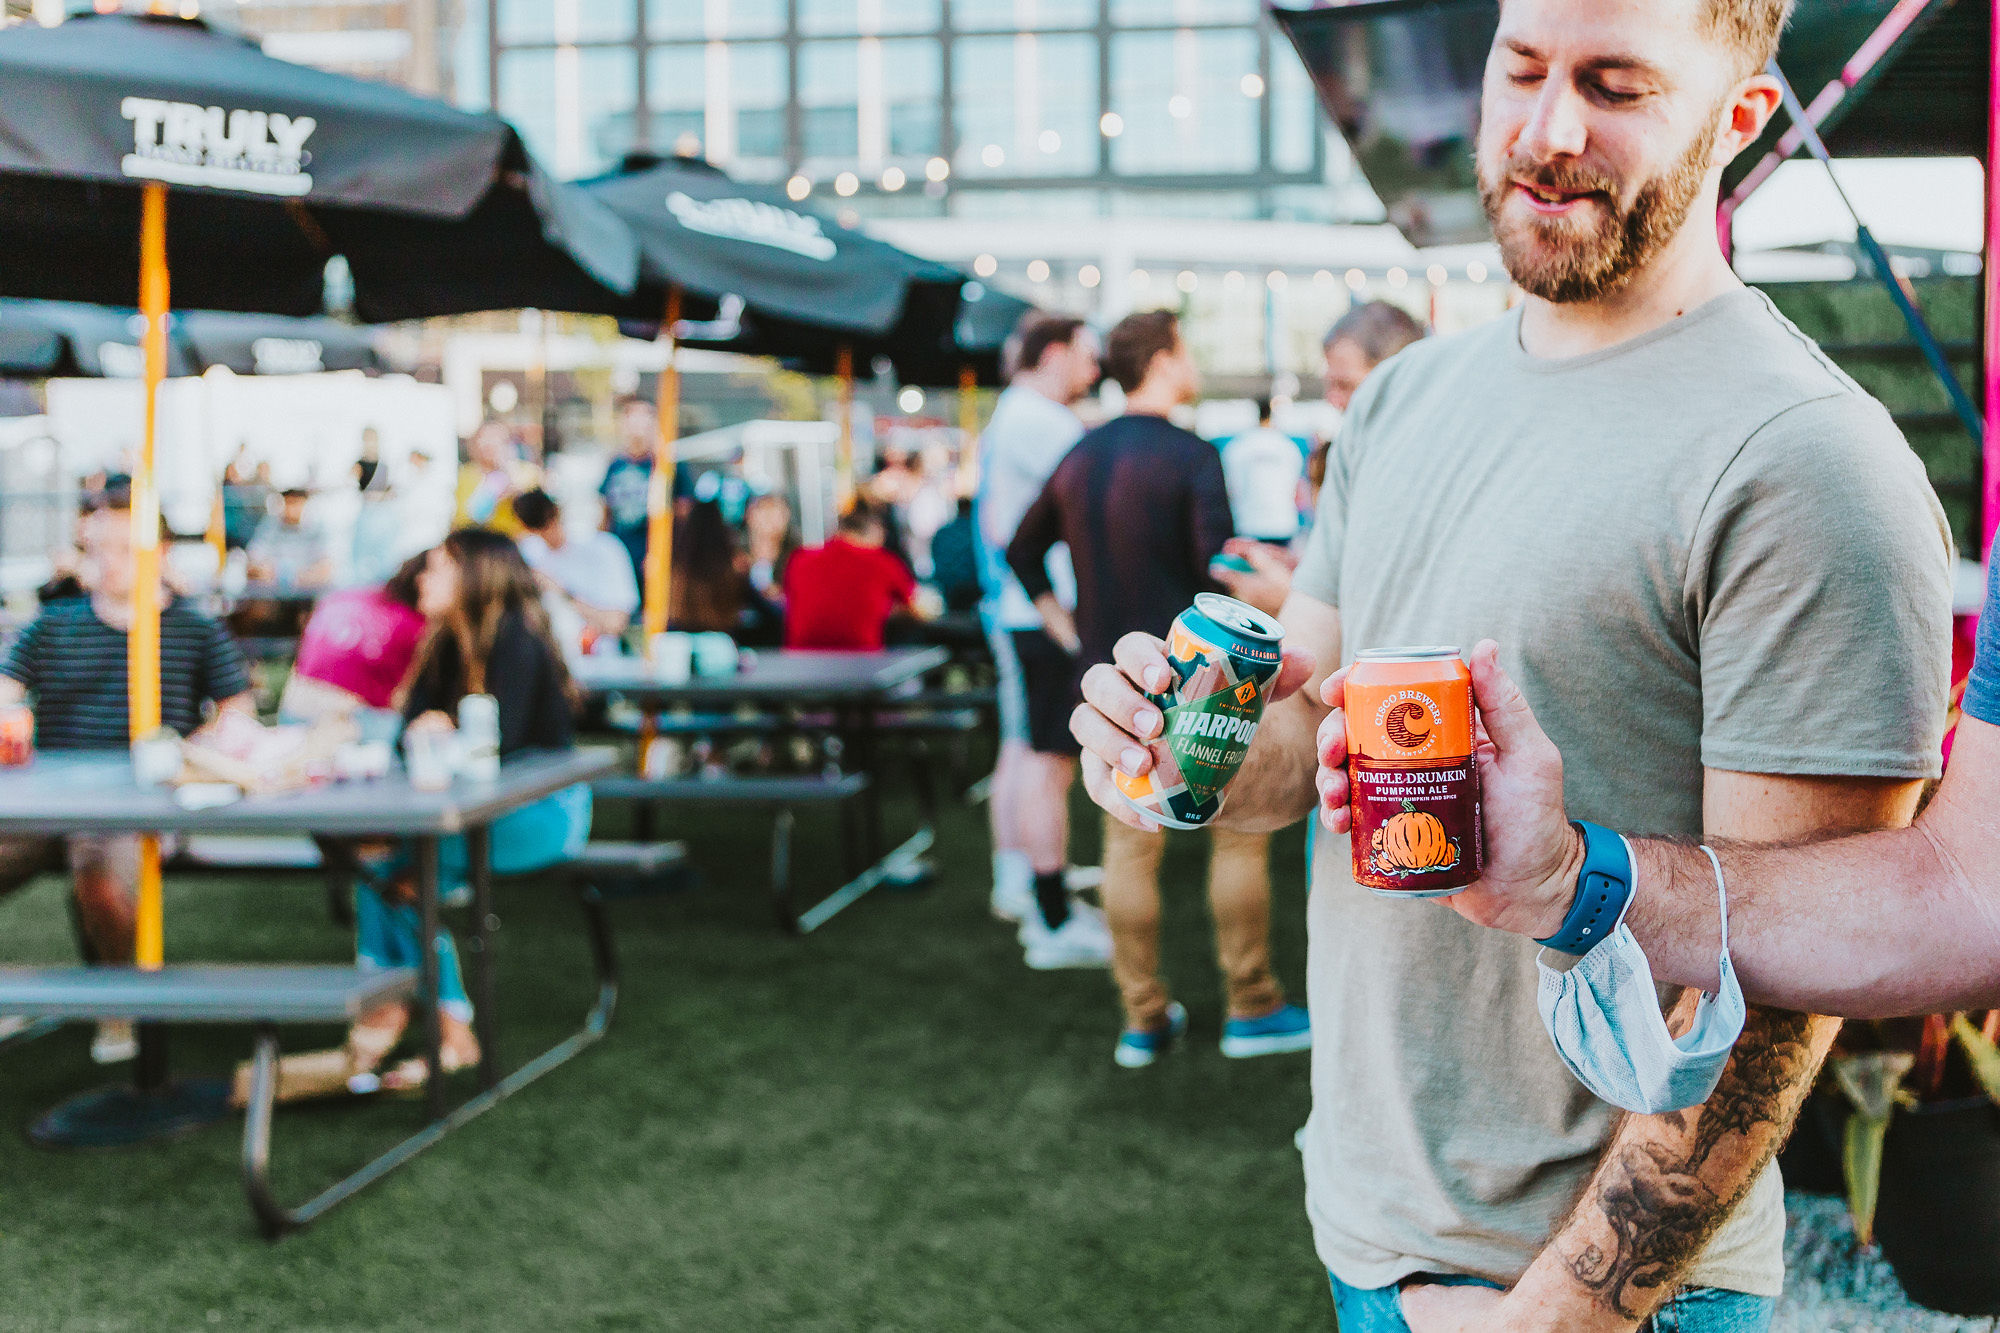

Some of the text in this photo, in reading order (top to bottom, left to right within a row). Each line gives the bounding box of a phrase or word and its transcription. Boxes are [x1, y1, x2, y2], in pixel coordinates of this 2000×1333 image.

[121, 96, 317, 158] TRULY
[1231, 643, 1248, 655] FALL
[1375, 690, 1442, 726] CISCO BREWERS
[1176, 737, 1222, 763] FLANNEL
[1357, 771, 1403, 784] PUMPLE
[1406, 769, 1467, 784] DRUMKIN
[1376, 785, 1449, 795] PUMPKIN ALE
